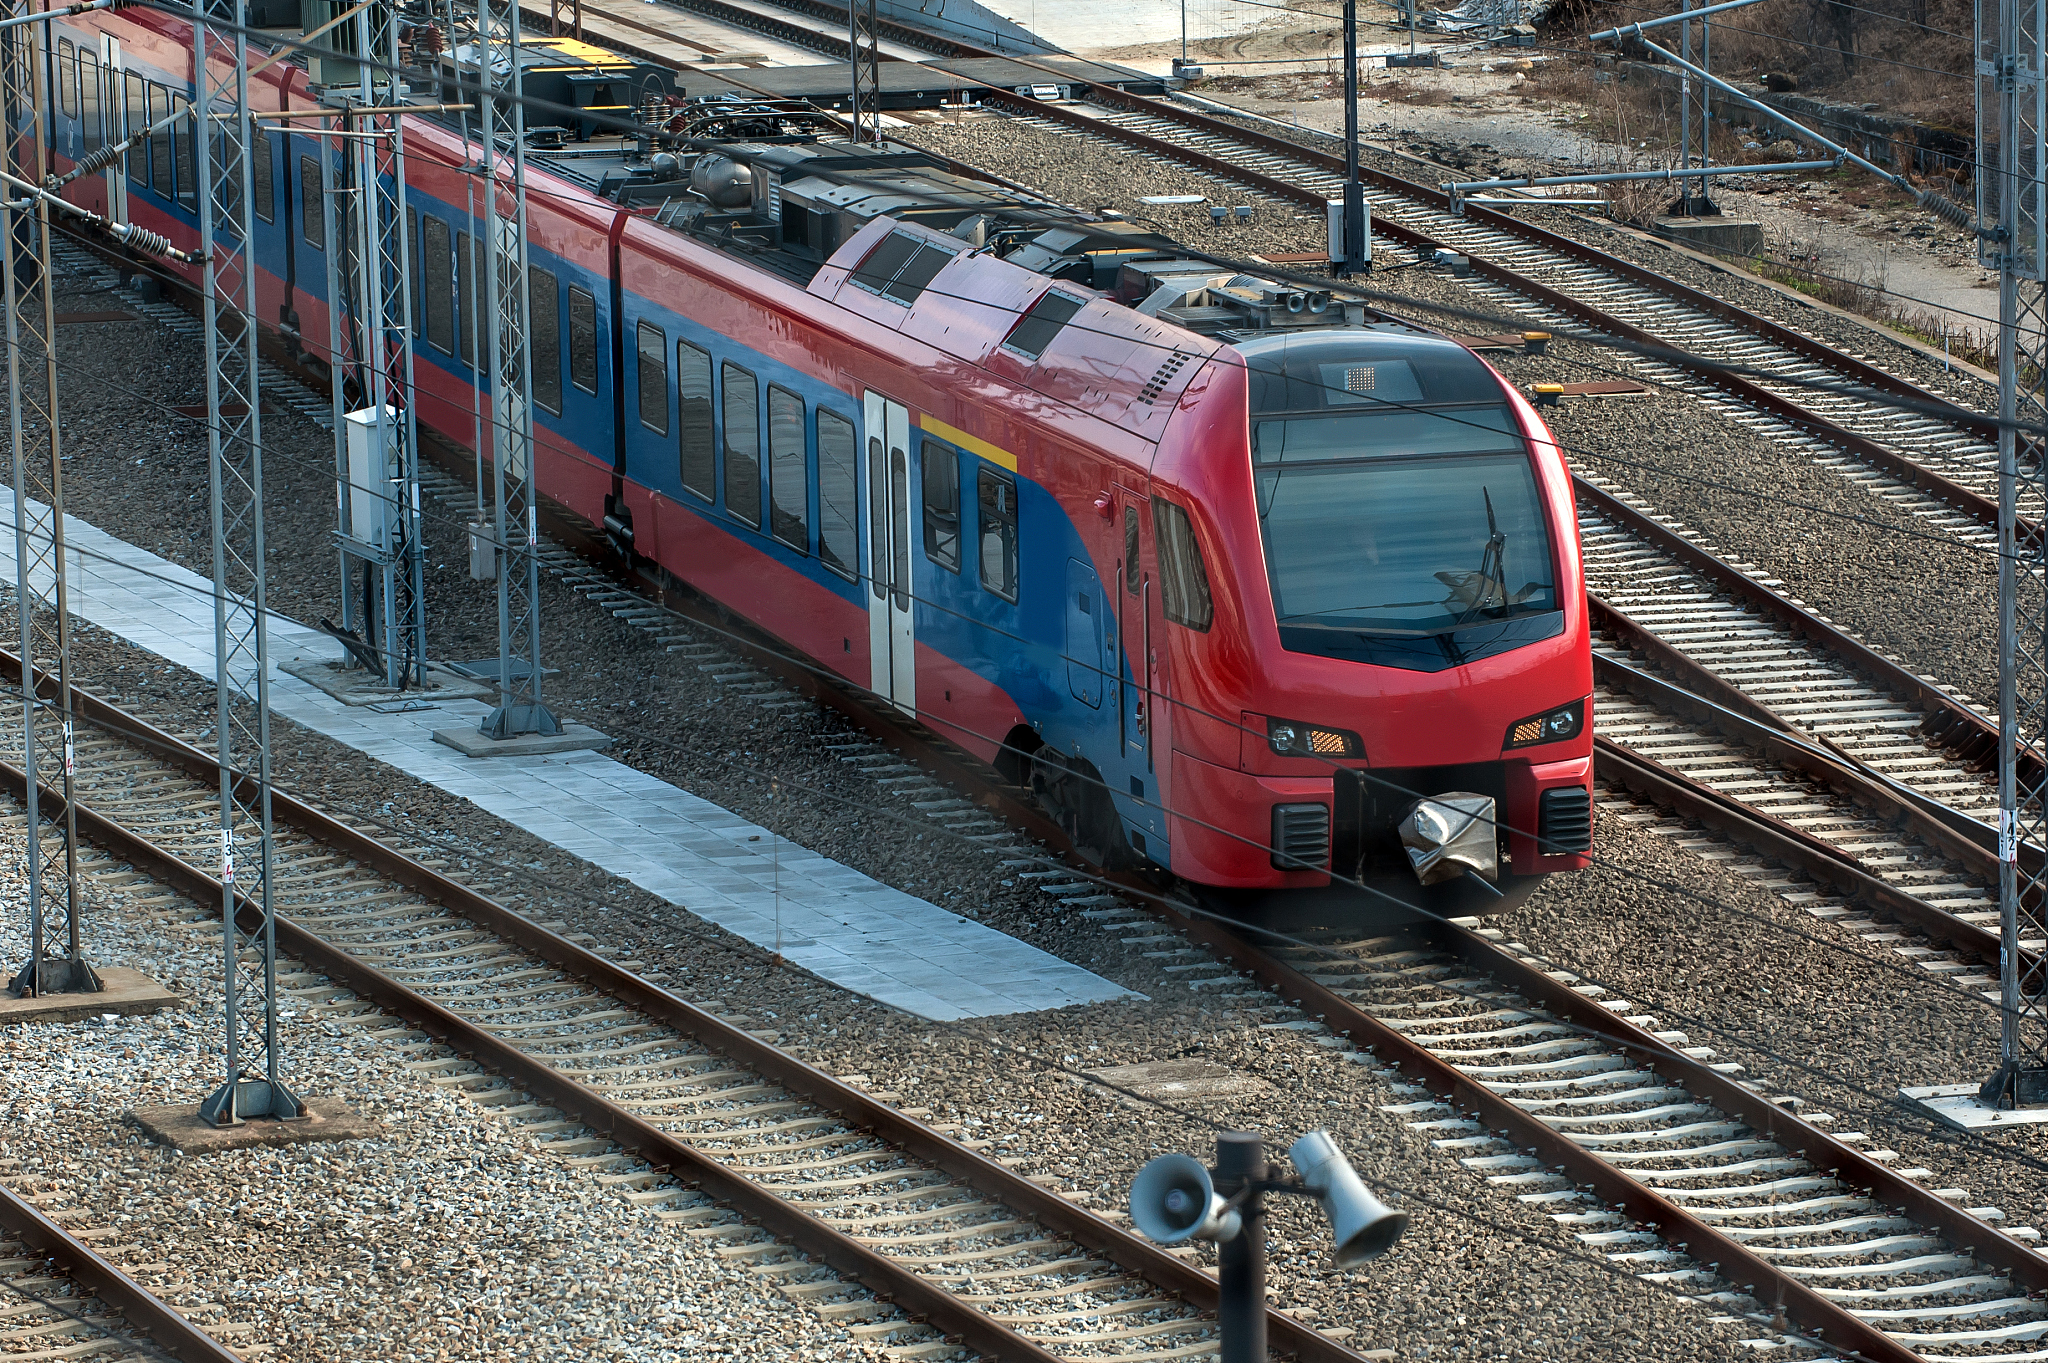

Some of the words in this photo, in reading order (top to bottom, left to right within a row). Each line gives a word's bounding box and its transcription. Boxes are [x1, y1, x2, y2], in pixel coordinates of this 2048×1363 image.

[452, 250, 458, 281] 2
[65, 721, 72, 745] 14
[225, 830, 232, 857] 13
